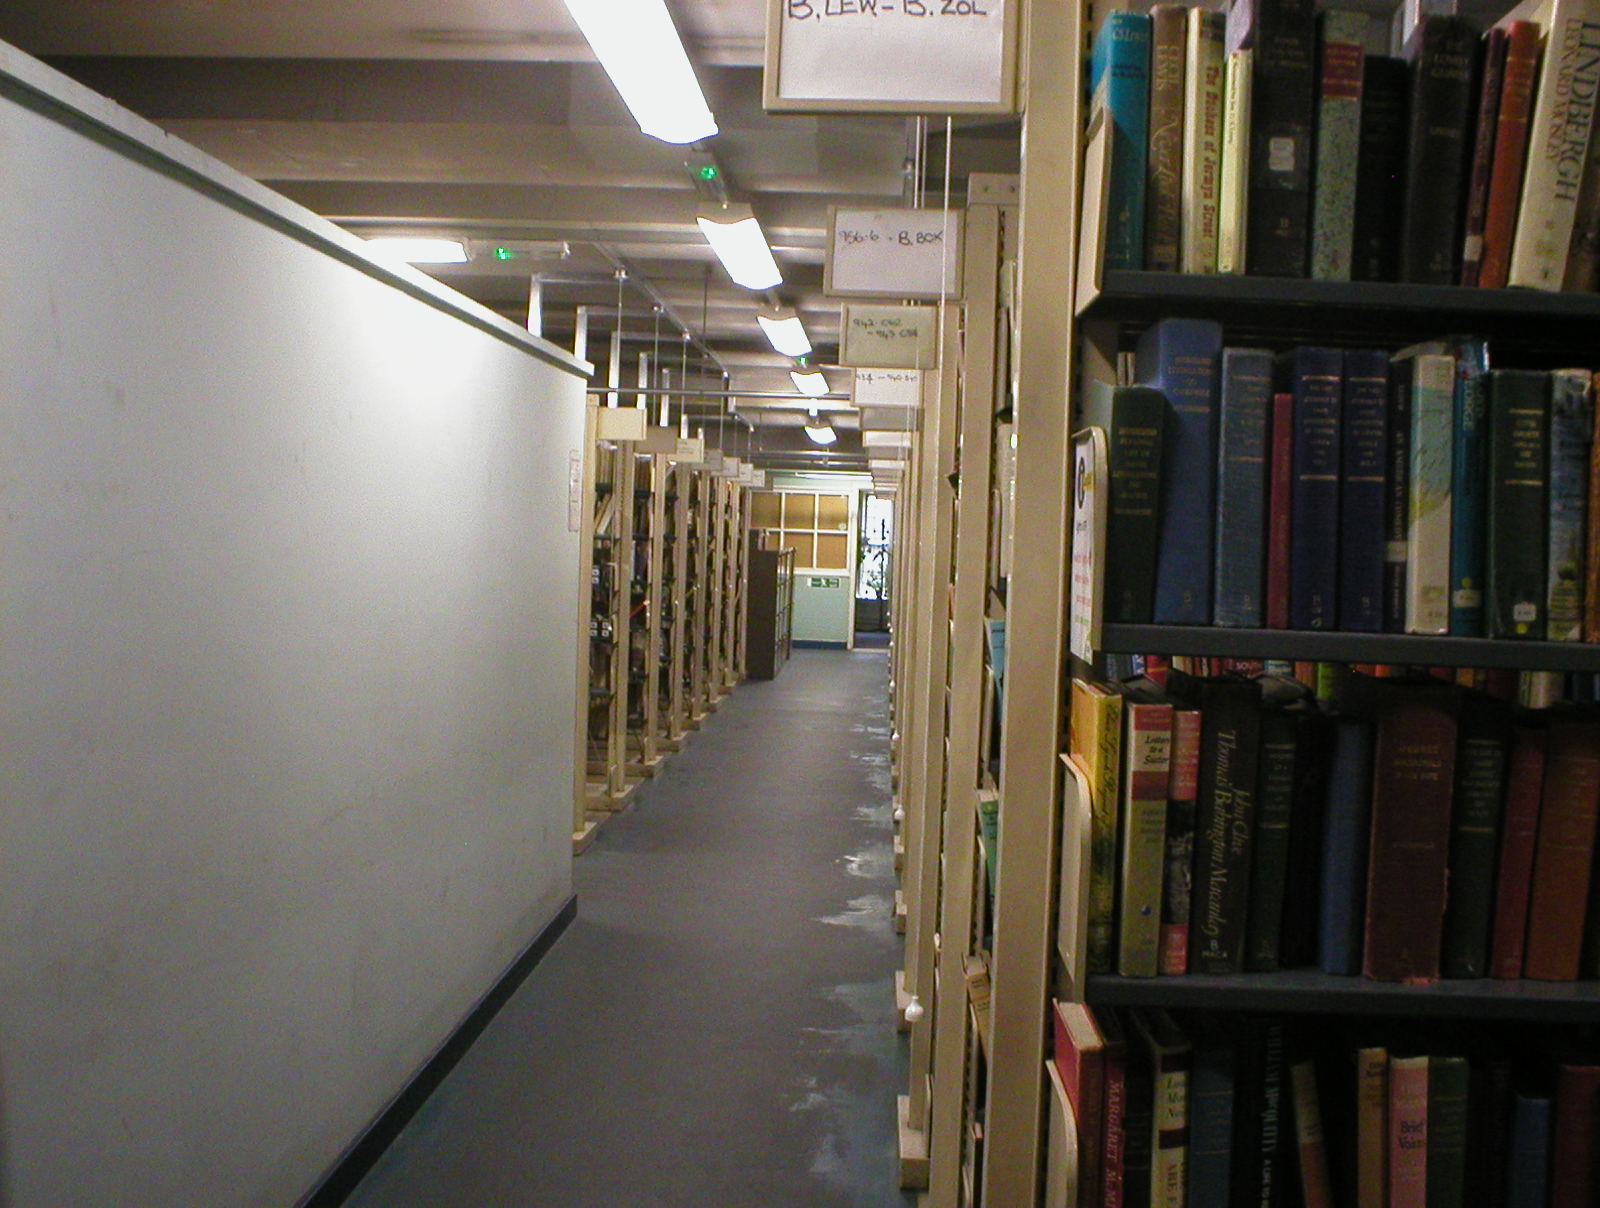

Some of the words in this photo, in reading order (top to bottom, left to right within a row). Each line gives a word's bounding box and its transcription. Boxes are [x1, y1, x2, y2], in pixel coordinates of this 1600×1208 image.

[1206, 66, 1220, 86] The
[1555, 21, 1600, 200] LINDBERGH
[1204, 140, 1217, 155] of
[1202, 204, 1216, 239] Street
[1144, 754, 1170, 765] Sister
[1216, 729, 1237, 788] Thomas
[1229, 787, 1252, 819] John
[1206, 789, 1232, 862] Babington
[1231, 821, 1249, 856] Clive
[1201, 863, 1228, 937] Macaulay
[1106, 1079, 1120, 1163] MARGARET
